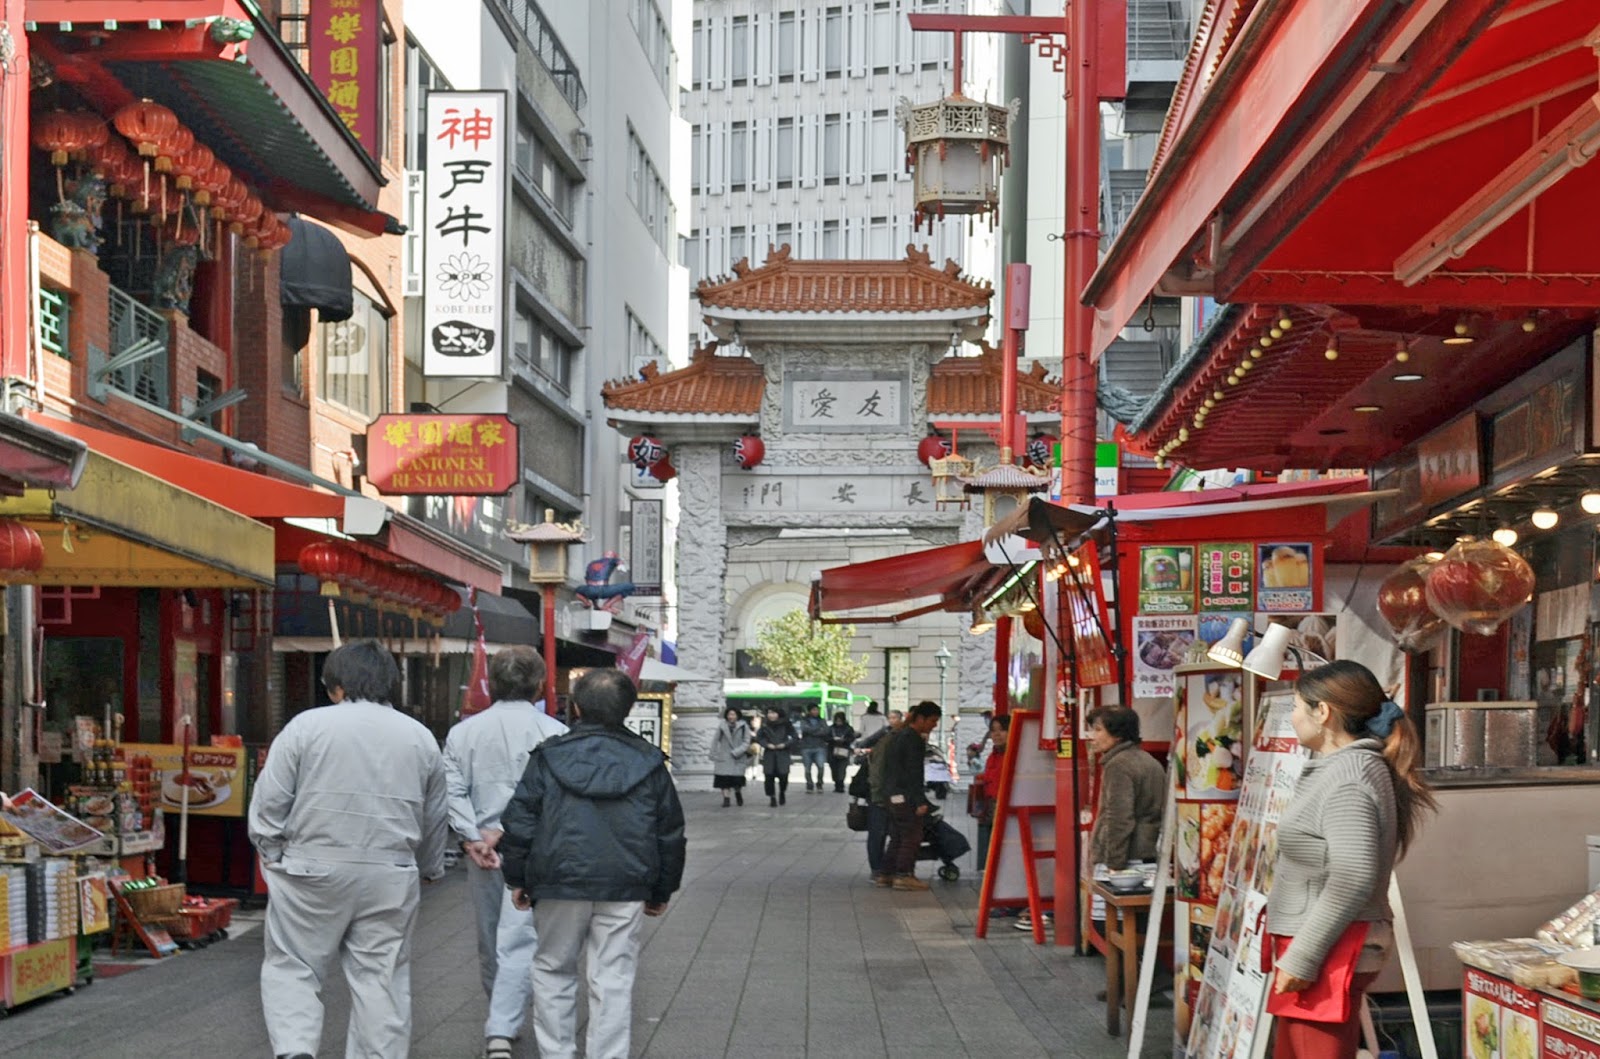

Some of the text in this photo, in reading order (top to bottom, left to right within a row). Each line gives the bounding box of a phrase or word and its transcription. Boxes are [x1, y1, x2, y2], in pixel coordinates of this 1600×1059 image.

[435, 108, 493, 248] 神戸牛
[435, 305, 494, 314] KOBE BEEF
[396, 457, 485, 471] CANTONESE
[392, 473, 494, 488] RESTAURANT
